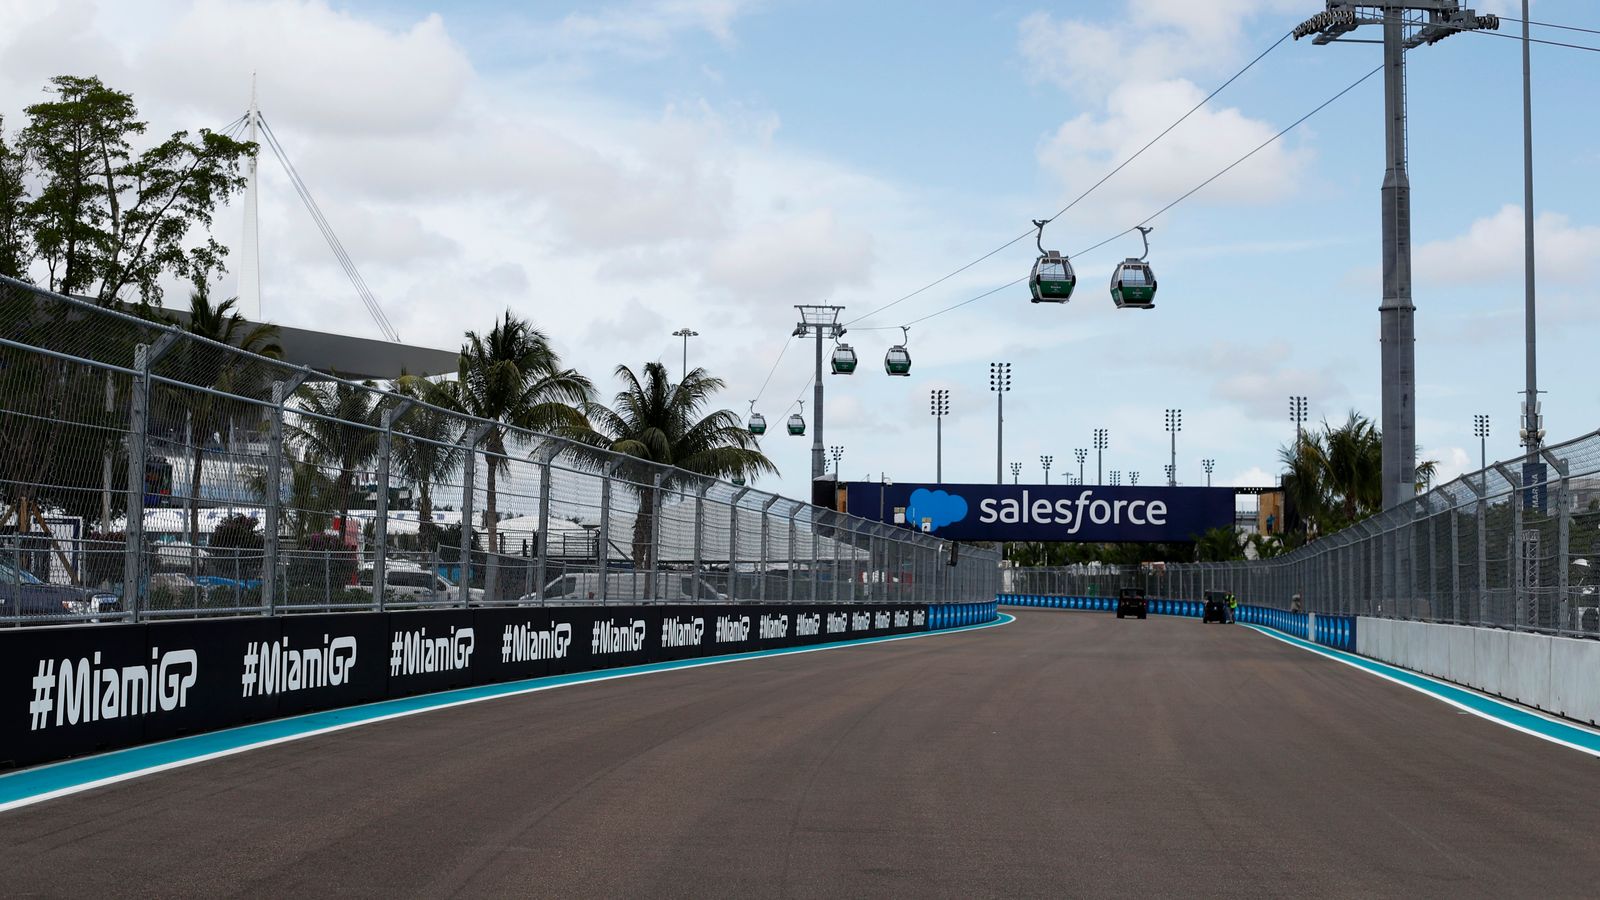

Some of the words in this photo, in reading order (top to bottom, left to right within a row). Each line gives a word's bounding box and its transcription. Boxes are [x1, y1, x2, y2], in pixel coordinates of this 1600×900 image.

[980, 490, 1168, 534] salesforce
[502, 621, 571, 663] #MiamiGP
[592, 618, 645, 654] #MiamiGP
[661, 616, 704, 648] #MiamiGP
[716, 615, 750, 643] #MiamiGP
[242, 634, 357, 698] #MiamiGP
[391, 626, 474, 676] #MiamiGP
[30, 647, 198, 731] #MiamiGP
